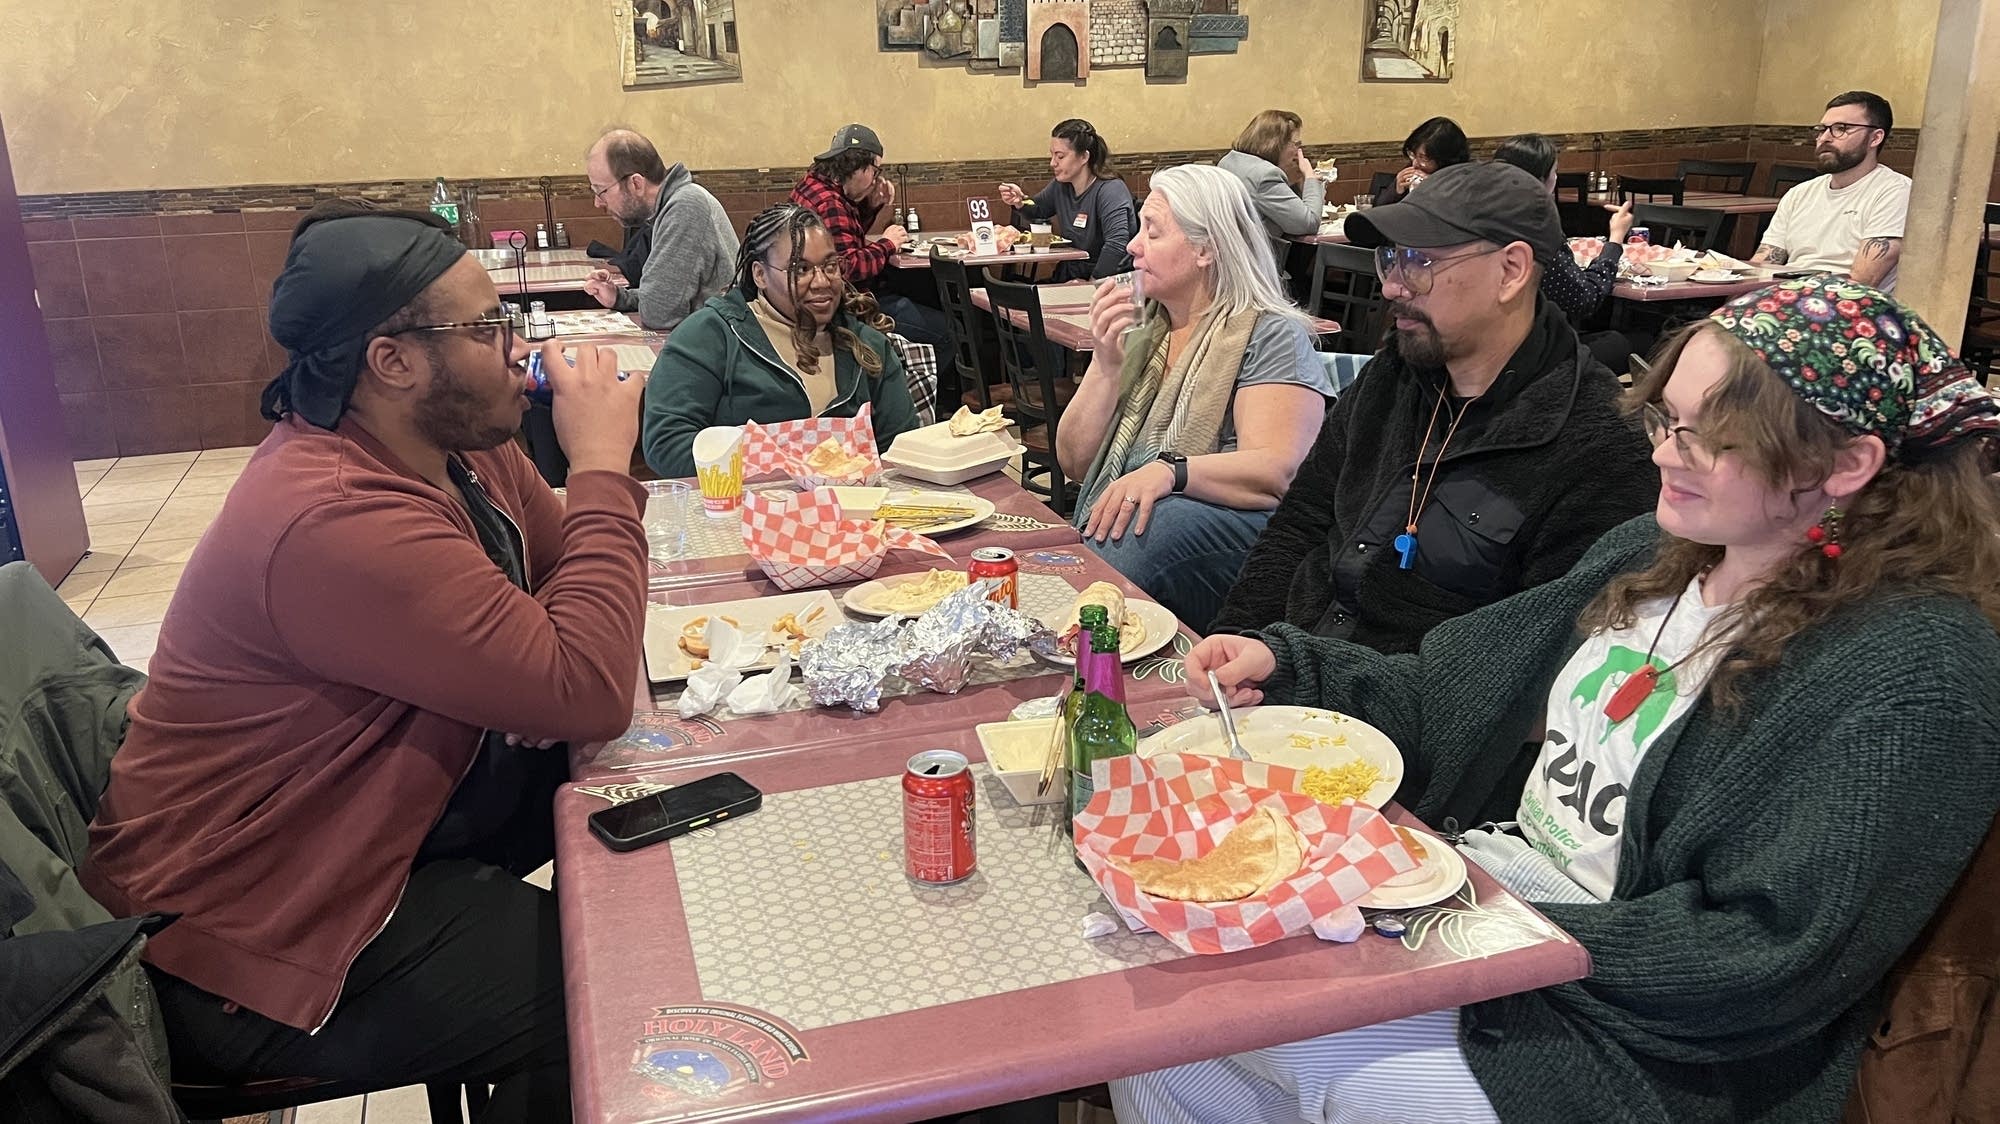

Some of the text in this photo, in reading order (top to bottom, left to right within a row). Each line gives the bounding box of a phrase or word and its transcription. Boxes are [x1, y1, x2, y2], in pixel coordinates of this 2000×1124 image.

[970, 199, 989, 219] 93
[1543, 814, 1583, 850] Police
[643, 1018, 729, 1037] HOLY
[726, 1028, 790, 1079] LAND
